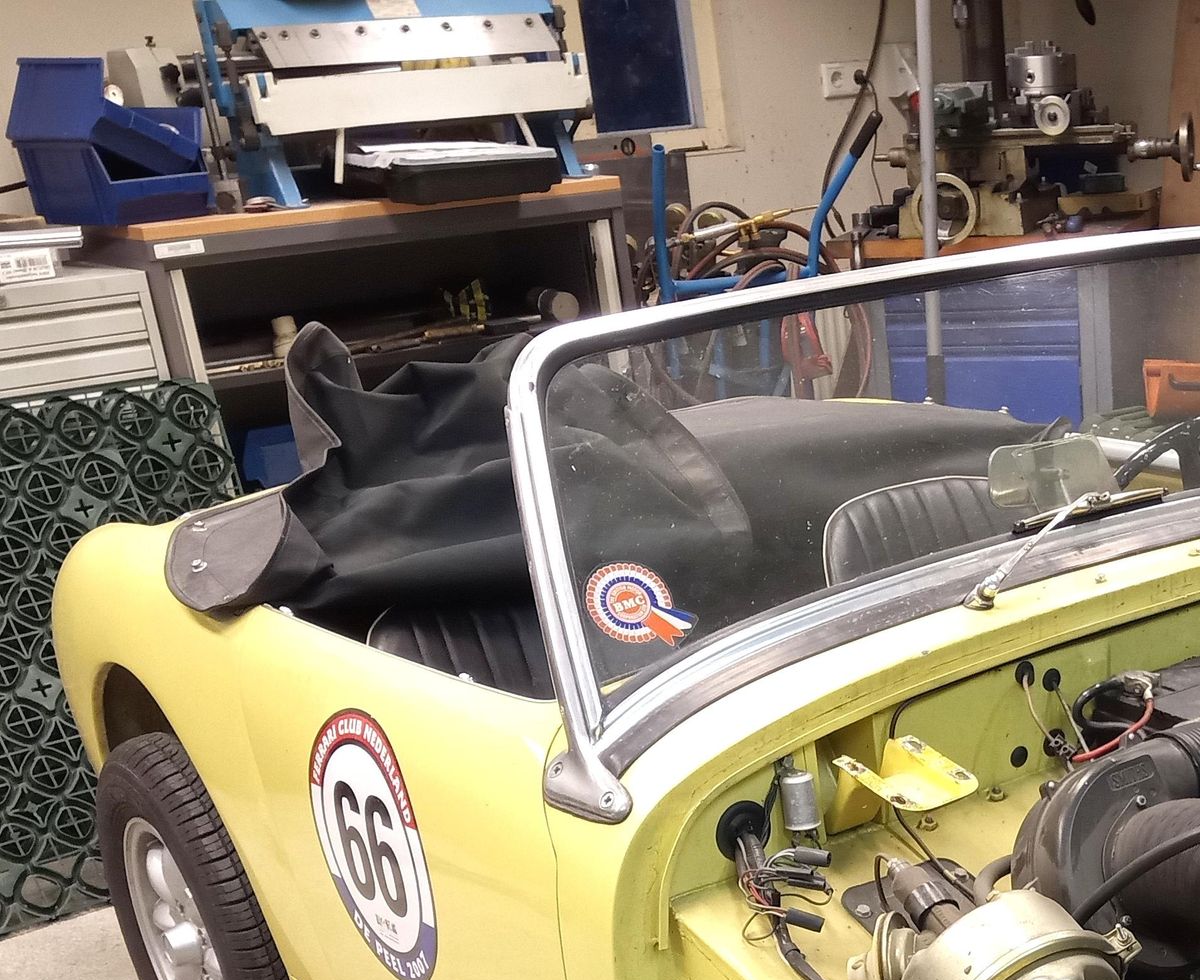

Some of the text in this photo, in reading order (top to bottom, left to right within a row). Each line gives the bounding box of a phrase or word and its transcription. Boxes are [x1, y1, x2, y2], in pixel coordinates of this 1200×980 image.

[613, 595, 646, 613] BMC
[338, 718, 362, 736] CLUB
[363, 723, 411, 824] NEDERLAND
[333, 780, 407, 918] 66
[353, 909, 371, 943] DE
[375, 939, 406, 976] PEEL
[406, 950, 429, 979] 2007
